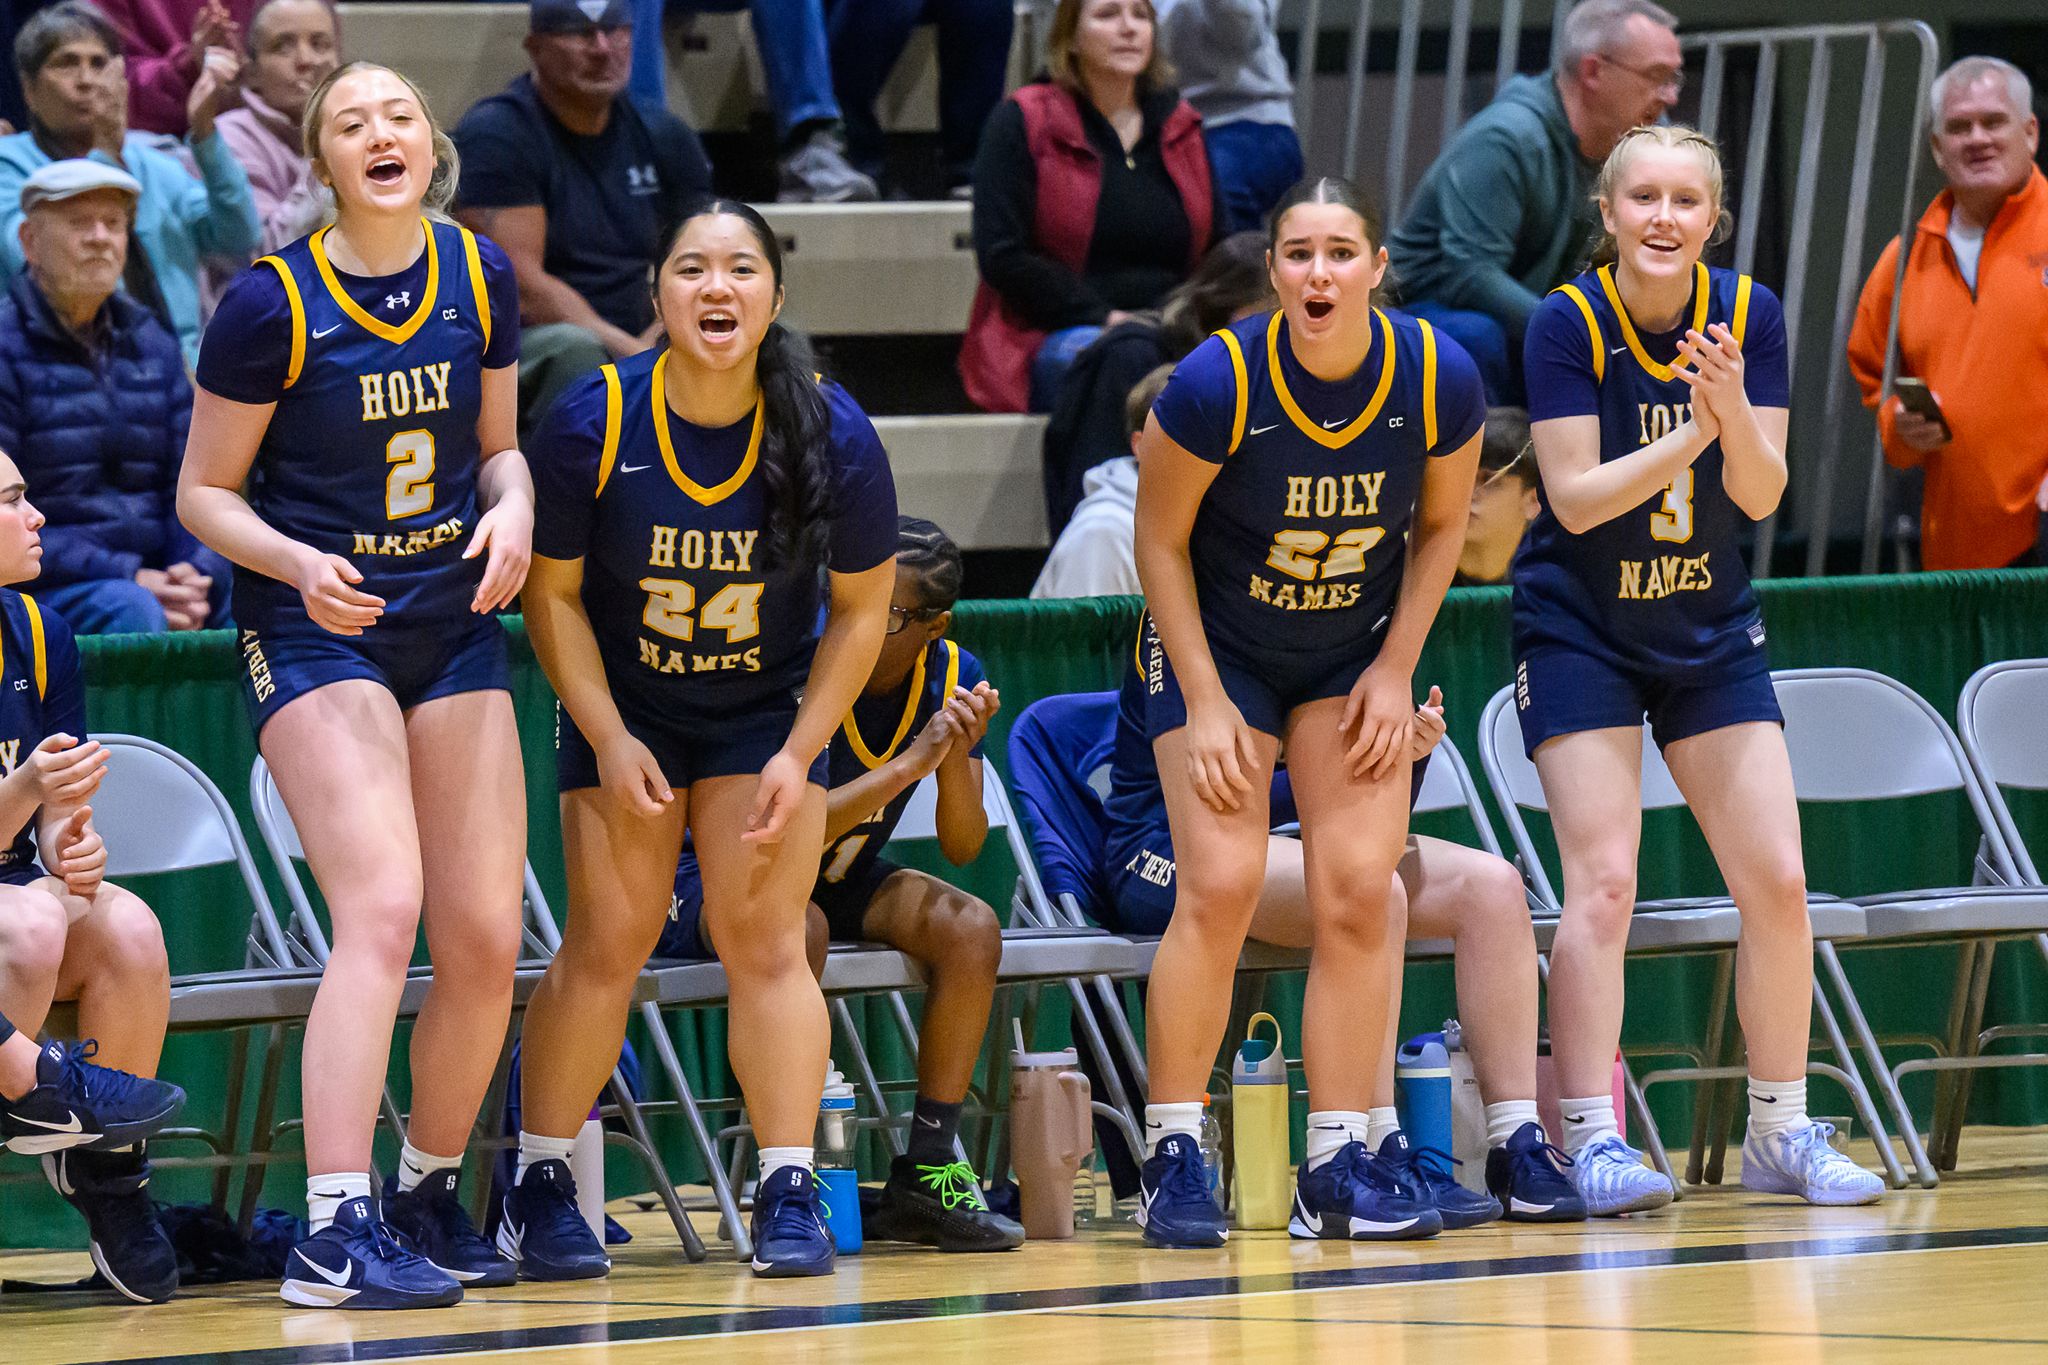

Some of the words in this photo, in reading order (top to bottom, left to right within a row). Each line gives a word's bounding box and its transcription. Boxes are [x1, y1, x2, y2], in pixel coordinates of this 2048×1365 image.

[442, 308, 458, 321] CC
[359, 360, 452, 422] HOLY
[1388, 416, 1404, 428] CC
[385, 428, 436, 520] 2
[1284, 470, 1386, 518] HOLY
[1650, 465, 1694, 545] 3
[648, 525, 759, 572] HOLY
[1265, 526, 1386, 581] 22
[1248, 574, 1362, 611] NAMES
[1618, 551, 1713, 600] NAMES
[638, 576, 765, 644] 24
[638, 636, 761, 674] NAMES
[14, 679, 29, 691] CC
